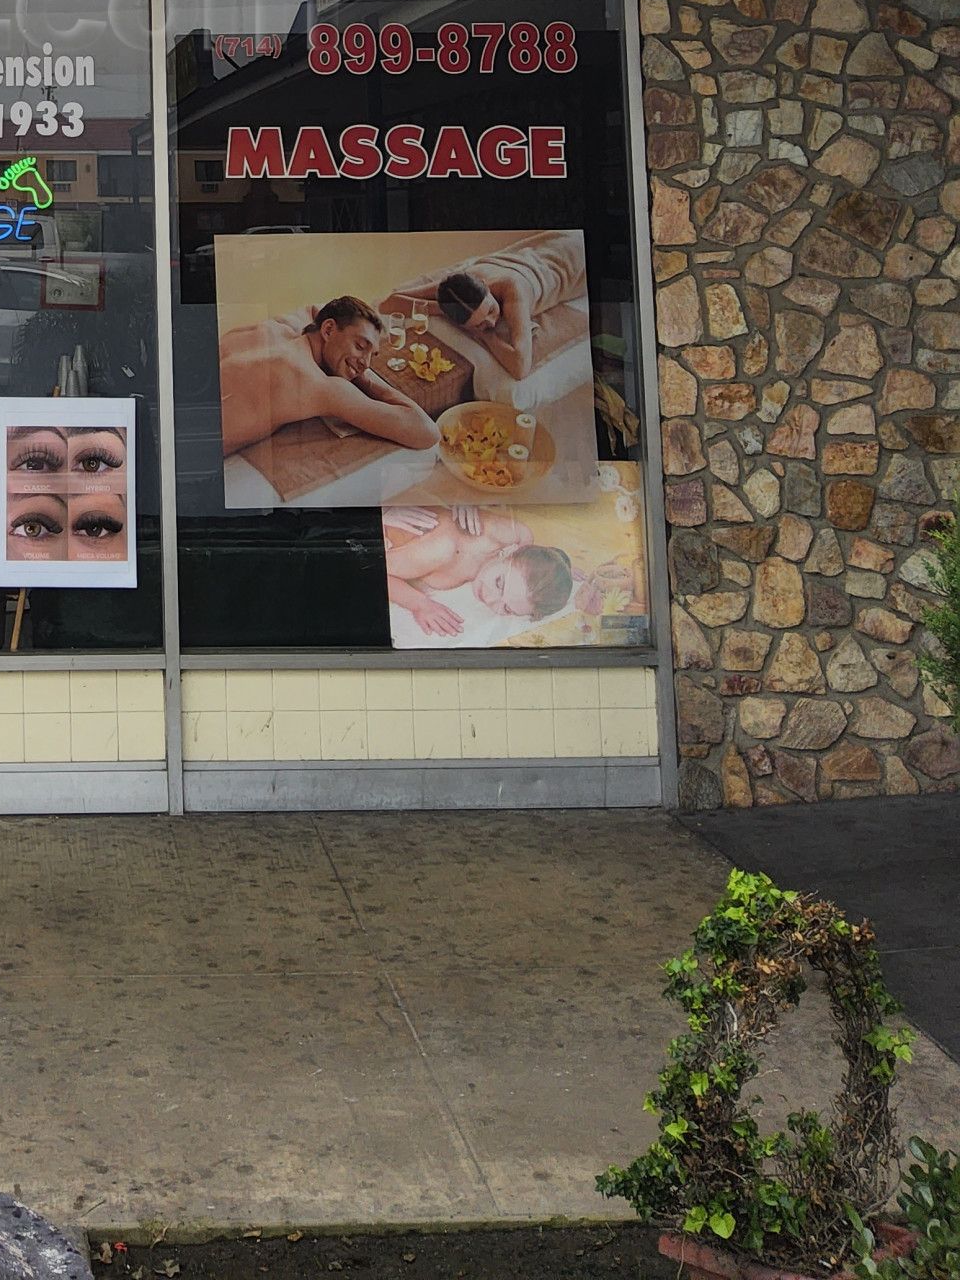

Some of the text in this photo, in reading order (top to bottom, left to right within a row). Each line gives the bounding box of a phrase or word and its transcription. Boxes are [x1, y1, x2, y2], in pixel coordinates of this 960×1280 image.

[215, 21, 578, 75] (714) 899-8788
[226, 124, 567, 180] MASSAGE
